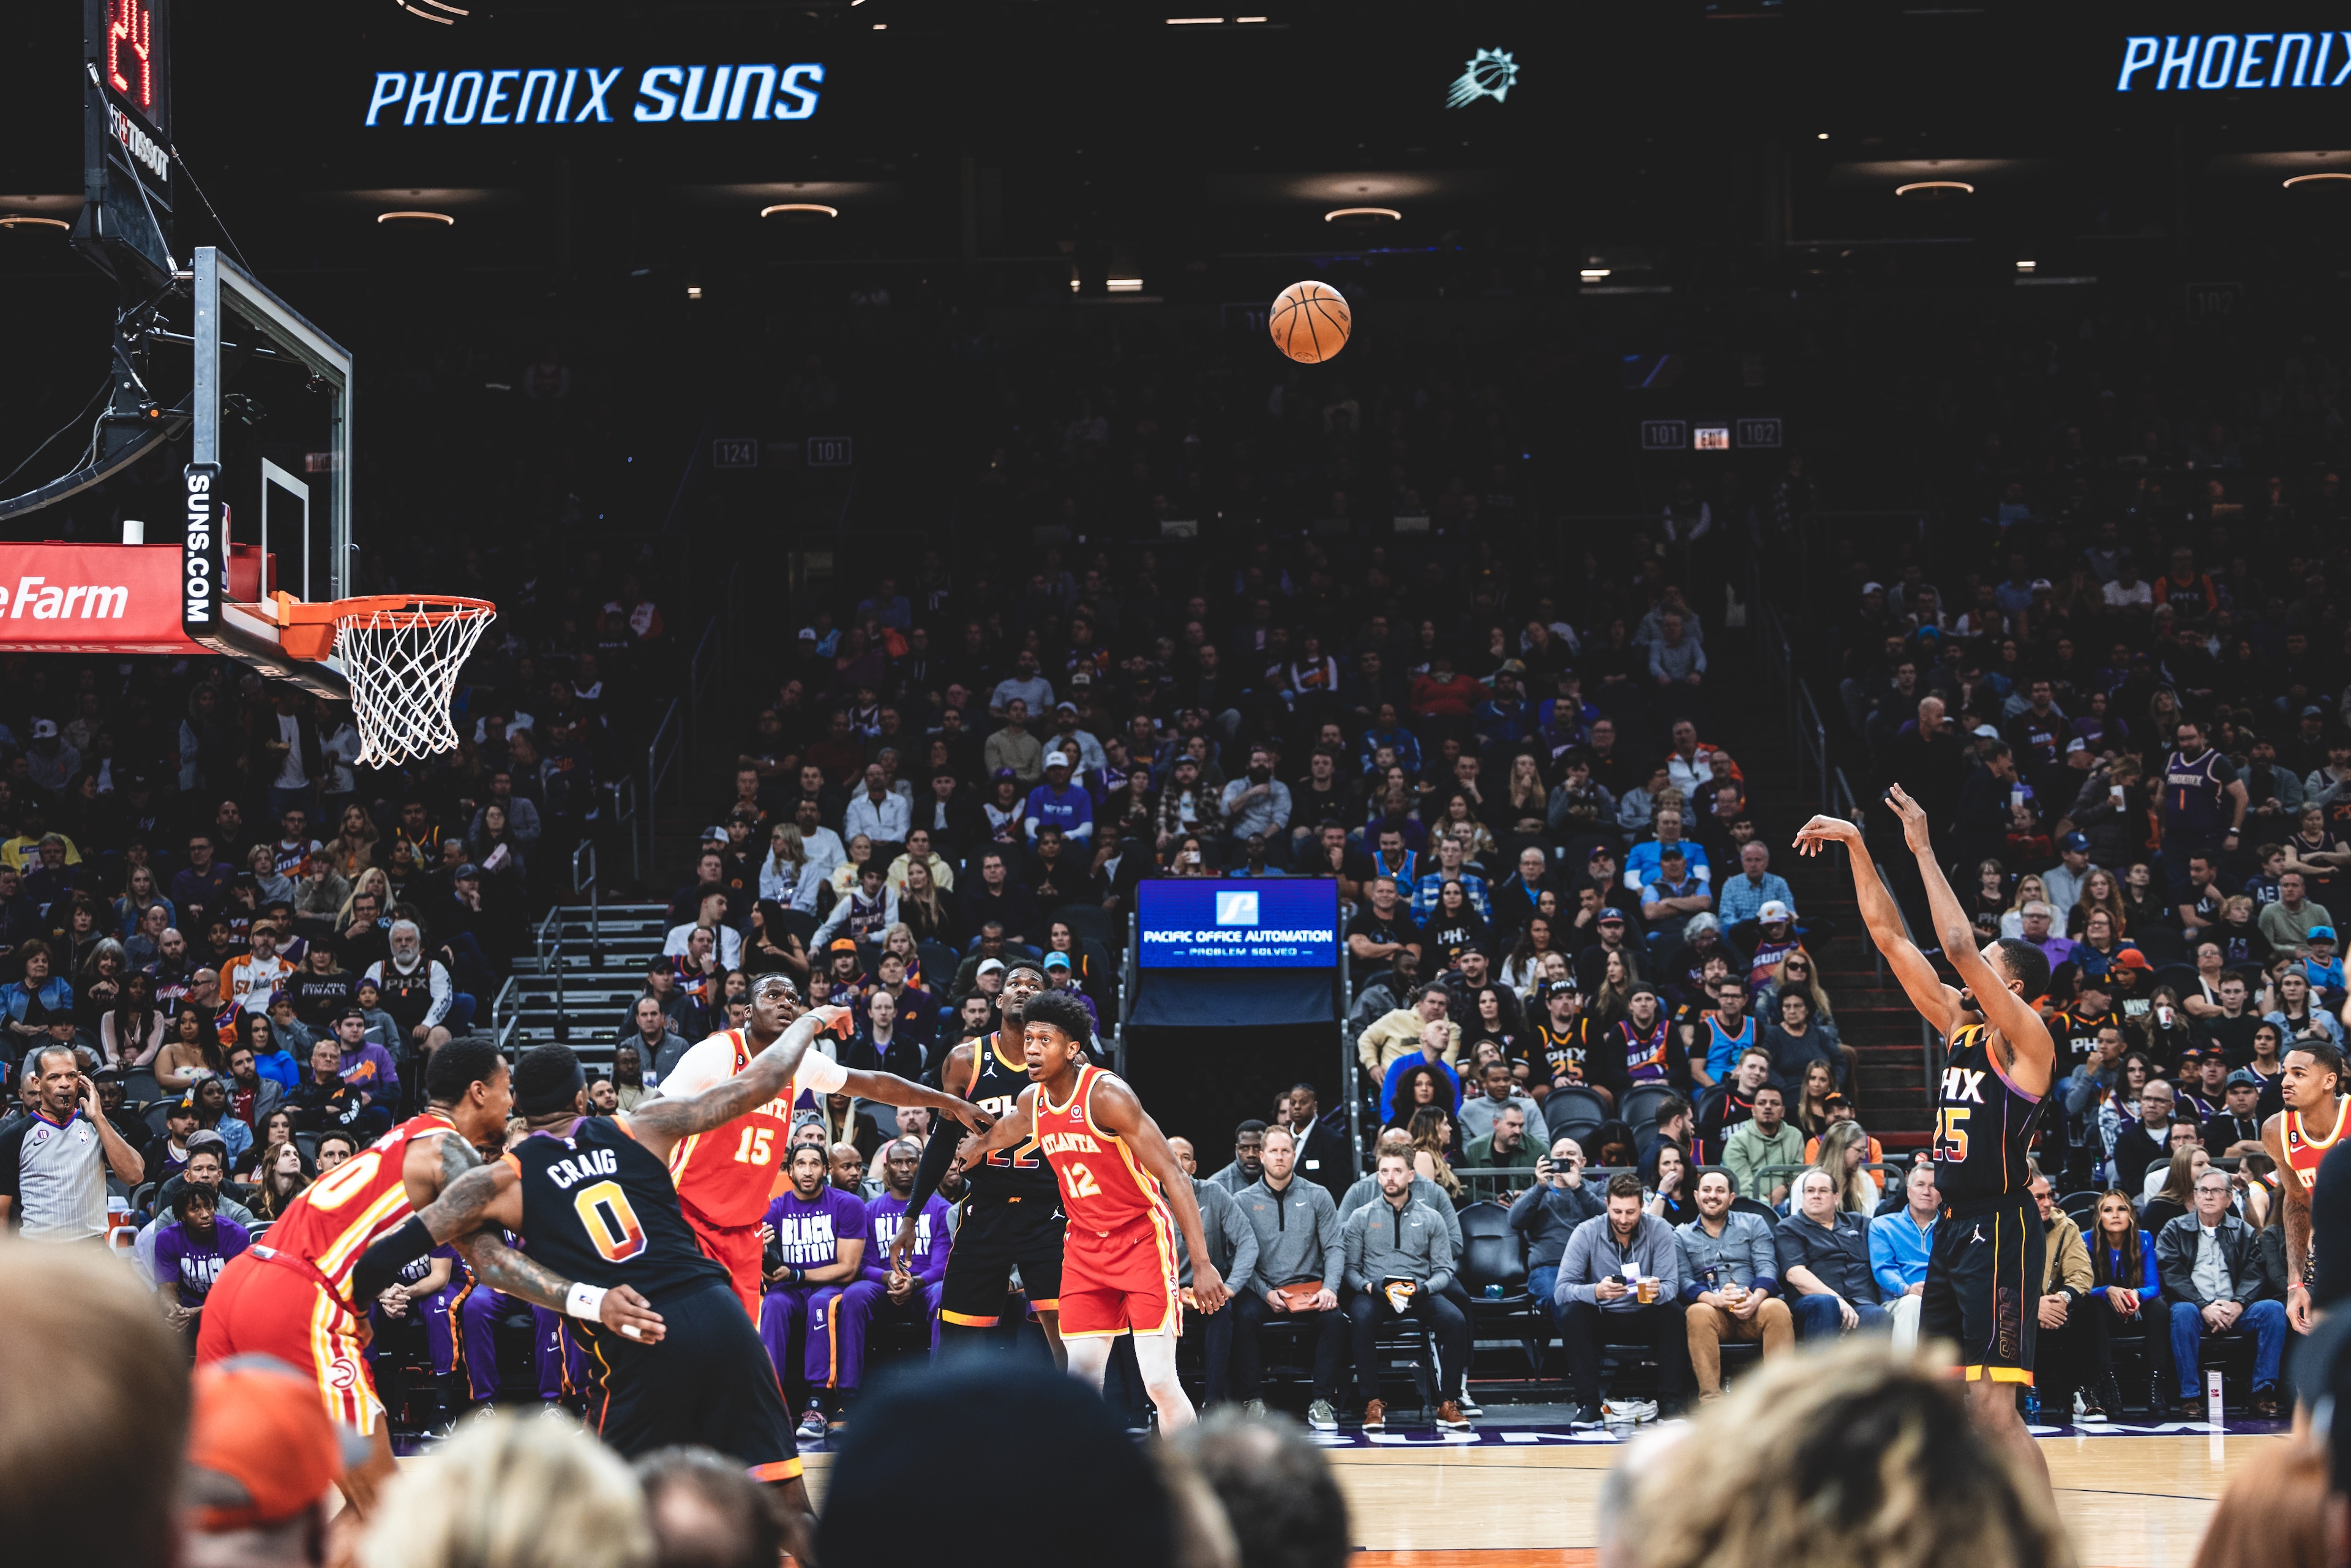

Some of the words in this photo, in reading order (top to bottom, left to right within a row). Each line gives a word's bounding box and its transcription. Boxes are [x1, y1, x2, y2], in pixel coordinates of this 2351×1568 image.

[366, 67, 623, 126] PHOENIX
[632, 63, 825, 122] SUNS
[127, 118, 170, 182] TISSOT
[187, 474, 210, 623] SUNS.COM
[10, 576, 129, 620] Farm
[1143, 931, 1193, 943] PACIFIC
[1196, 931, 1242, 943] OFFICE
[1245, 930, 1333, 943] AUTOMATION
[386, 978, 427, 991] PHX
[984, 1051, 992, 1061] 6
[1545, 1048, 1587, 1065] PHX
[2071, 1037, 2099, 1053] PH
[738, 1054, 746, 1065] 6
[980, 1095, 1018, 1117] PH
[735, 1127, 774, 1166] 15
[1041, 1132, 1102, 1157] ATLANTA
[2290, 1131, 2297, 1144] 6
[547, 1149, 618, 1189] CRAIG
[1062, 1161, 1102, 1199] 12
[574, 1180, 648, 1262] 0
[781, 1216, 835, 1246] BLACK
[782, 1240, 835, 1264] HISTORY
[1998, 1286, 2020, 1362] SUNS
